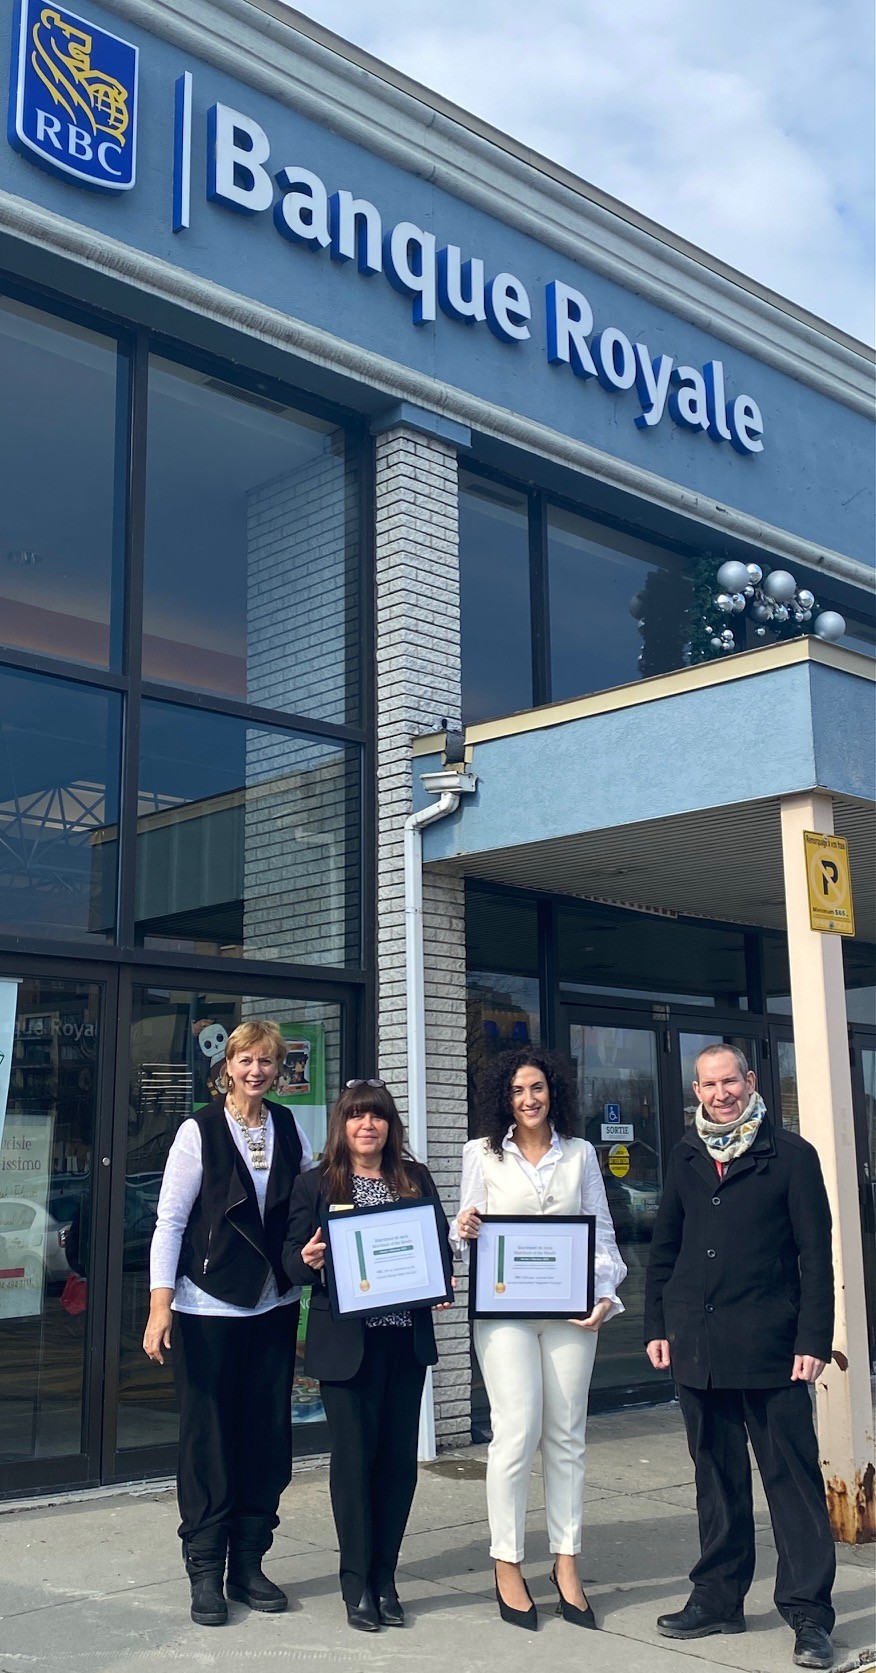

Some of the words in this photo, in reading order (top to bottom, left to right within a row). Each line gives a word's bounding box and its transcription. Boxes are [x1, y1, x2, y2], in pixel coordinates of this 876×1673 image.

[35, 108, 123, 176] RBC
[208, 102, 533, 341] Banque
[547, 279, 765, 453] Royale
[606, 1126, 629, 1134] SORTIE
[2, 1156, 42, 1171] issimo
